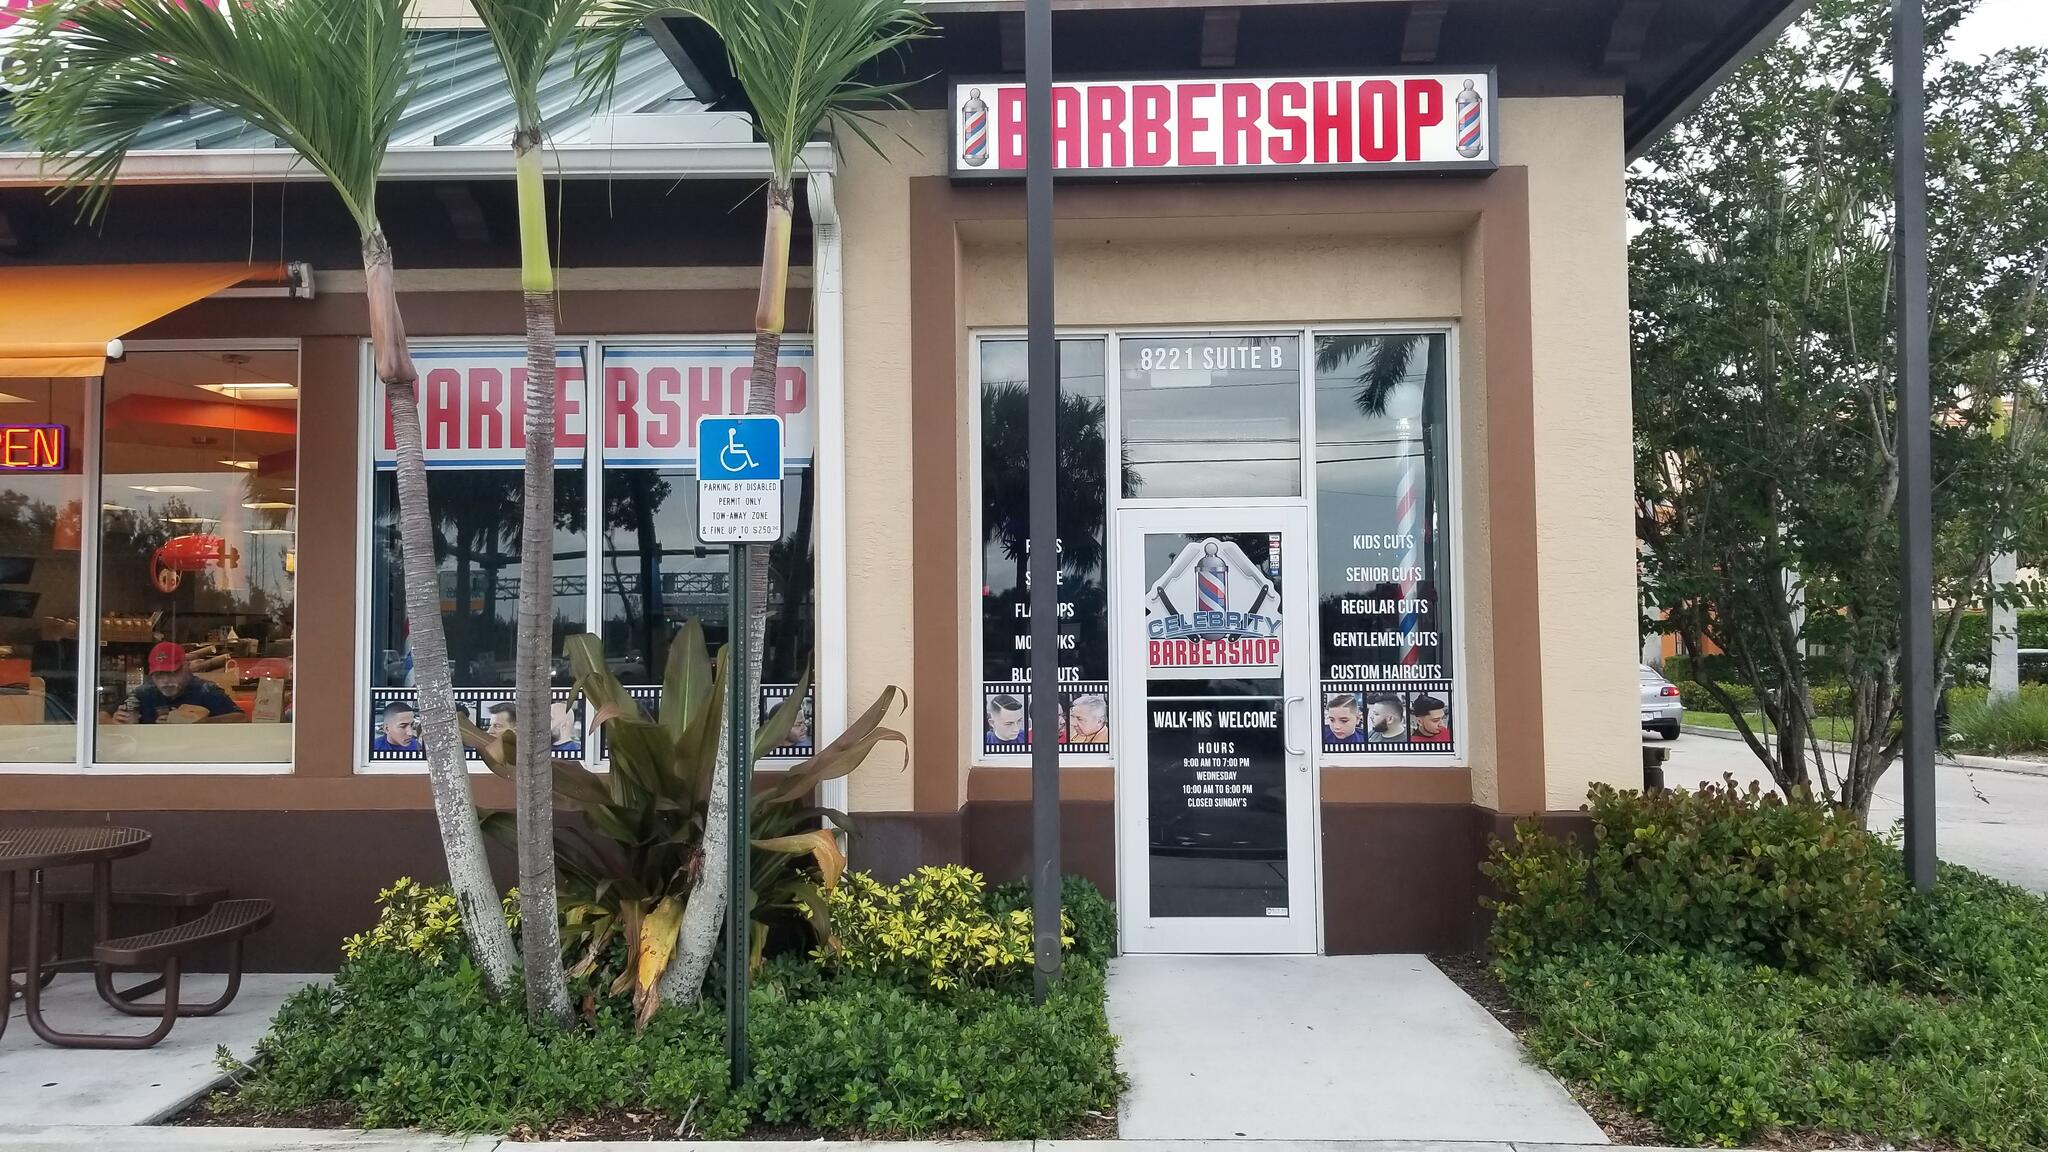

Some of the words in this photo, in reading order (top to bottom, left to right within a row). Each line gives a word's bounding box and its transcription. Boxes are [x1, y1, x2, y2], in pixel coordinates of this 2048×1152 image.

[998, 79, 1443, 169] BARBERSHOP
[1141, 347, 1192, 370] 8221
[1202, 347, 1261, 369] SUITE
[1270, 346, 1282, 369] B
[384, 367, 807, 450] ARERSHP
[0, 428, 58, 465] EN
[703, 483, 731, 491] PARKING
[734, 483, 743, 491] BY
[746, 482, 777, 491] DISABLED
[719, 497, 741, 505] PERMIT
[745, 497, 761, 505] ONLY
[713, 512, 747, 520] TOW-AWAY
[751, 512, 768, 520] ZONE
[702, 526, 707, 535] &
[710, 526, 724, 534] FINE
[728, 526, 737, 534] UP
[740, 526, 749, 534] TO
[1353, 534, 1380, 550] KIDS
[1383, 534, 1413, 550] CUTS
[1346, 567, 1388, 582] SENIOR
[1392, 566, 1422, 581] CUTS
[1341, 599, 1395, 614] REGULAR
[1398, 599, 1428, 614] CUTS
[1148, 611, 1282, 637] CELEBRITY
[1015, 634, 1075, 650] MOKS
[1333, 632, 1404, 647] GENTLEMEN
[1407, 631, 1438, 646] CUTS
[1149, 638, 1279, 665] BARBERSHOP
[1331, 664, 1380, 679] CUSTOM
[1382, 664, 1442, 679] HAIRCUTS
[1153, 711, 1213, 728] WALK-INS
[1218, 711, 1277, 728] WELCOME
[1198, 742, 1235, 754] HOURS
[1183, 758, 1199, 767] 9:00
[1200, 758, 1211, 767] AM
[1212, 758, 1221, 767] TO
[1222, 758, 1238, 767] 7:00
[1239, 758, 1250, 767] PM
[1196, 771, 1238, 781] WEDNESDAY
[1182, 785, 1202, 794] 10:00
[1203, 785, 1214, 794] AM
[1215, 785, 1224, 794] TO
[1225, 785, 1241, 794] 6:00
[1242, 785, 1253, 794] PM
[1187, 798, 1213, 807] CLOSED
[1214, 798, 1247, 807] SUNDAY'S
